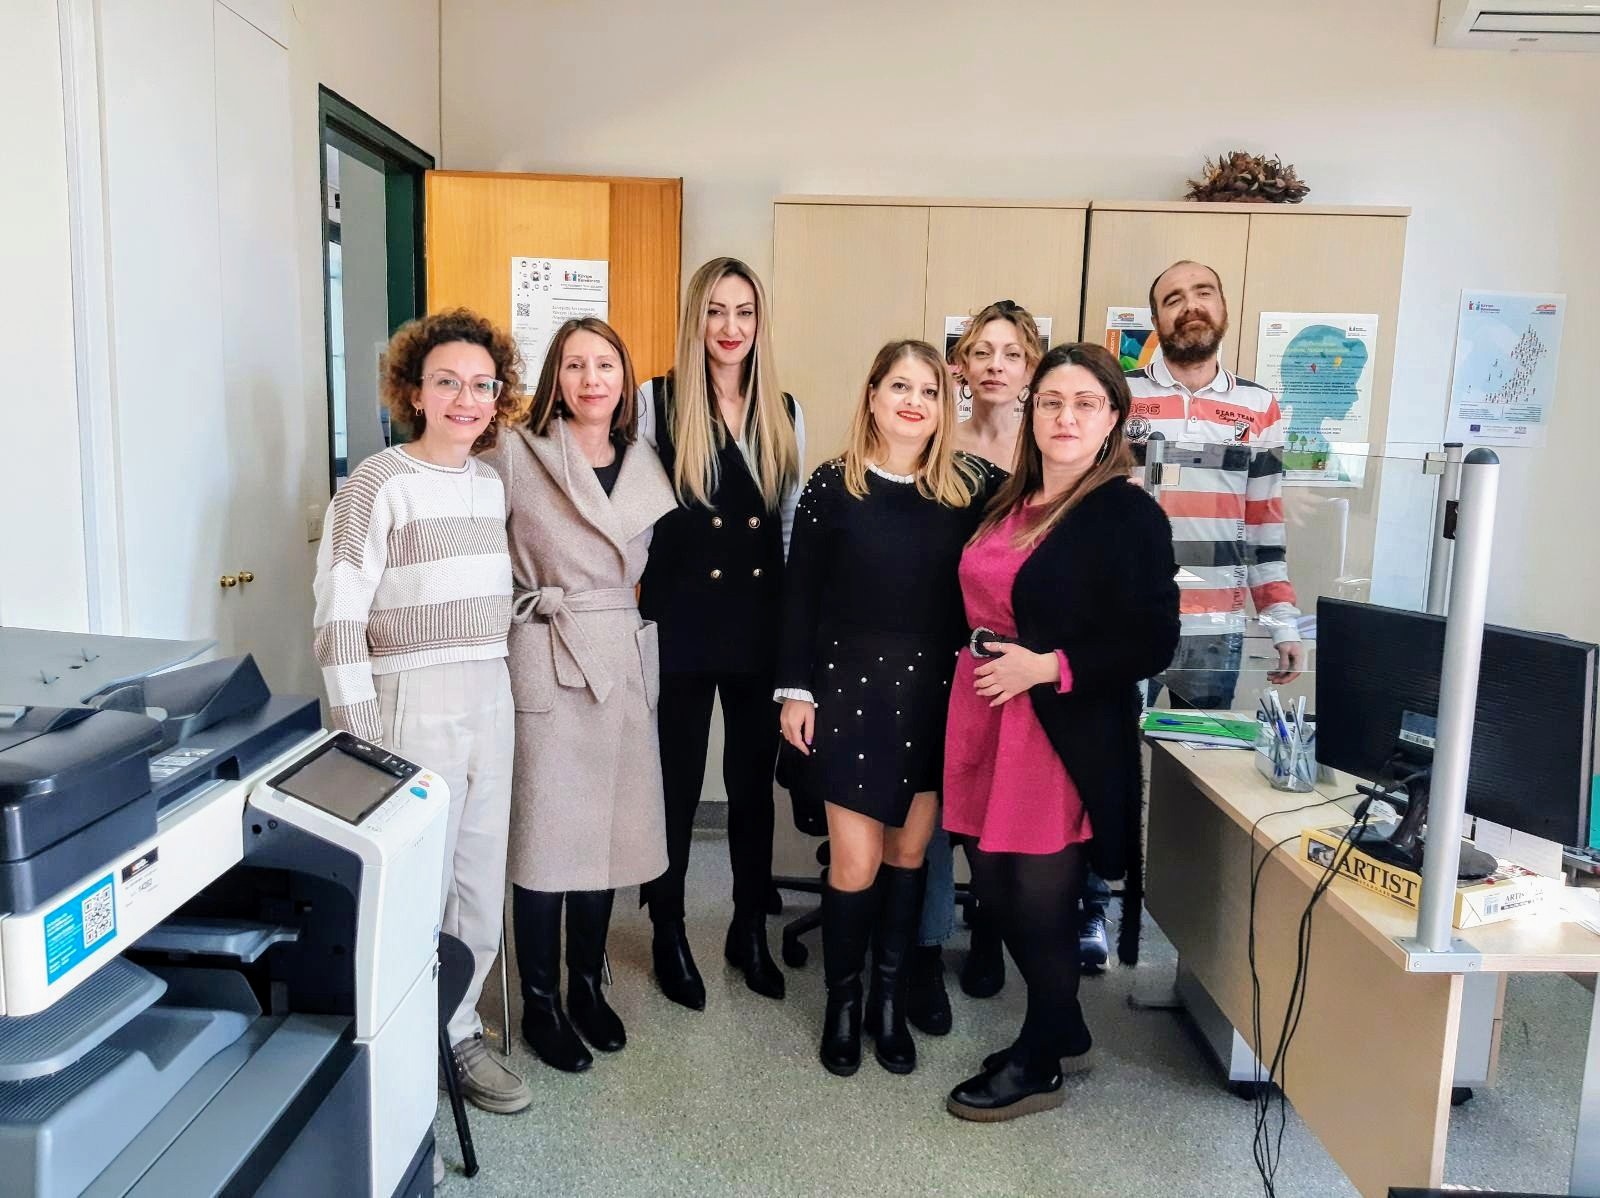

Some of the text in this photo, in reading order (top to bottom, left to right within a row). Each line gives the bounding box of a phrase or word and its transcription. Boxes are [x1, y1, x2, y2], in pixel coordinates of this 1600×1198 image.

[1215, 409, 1235, 418] STAR
[1236, 412, 1255, 423] TEAM
[1339, 854, 1418, 901] ARTIST
